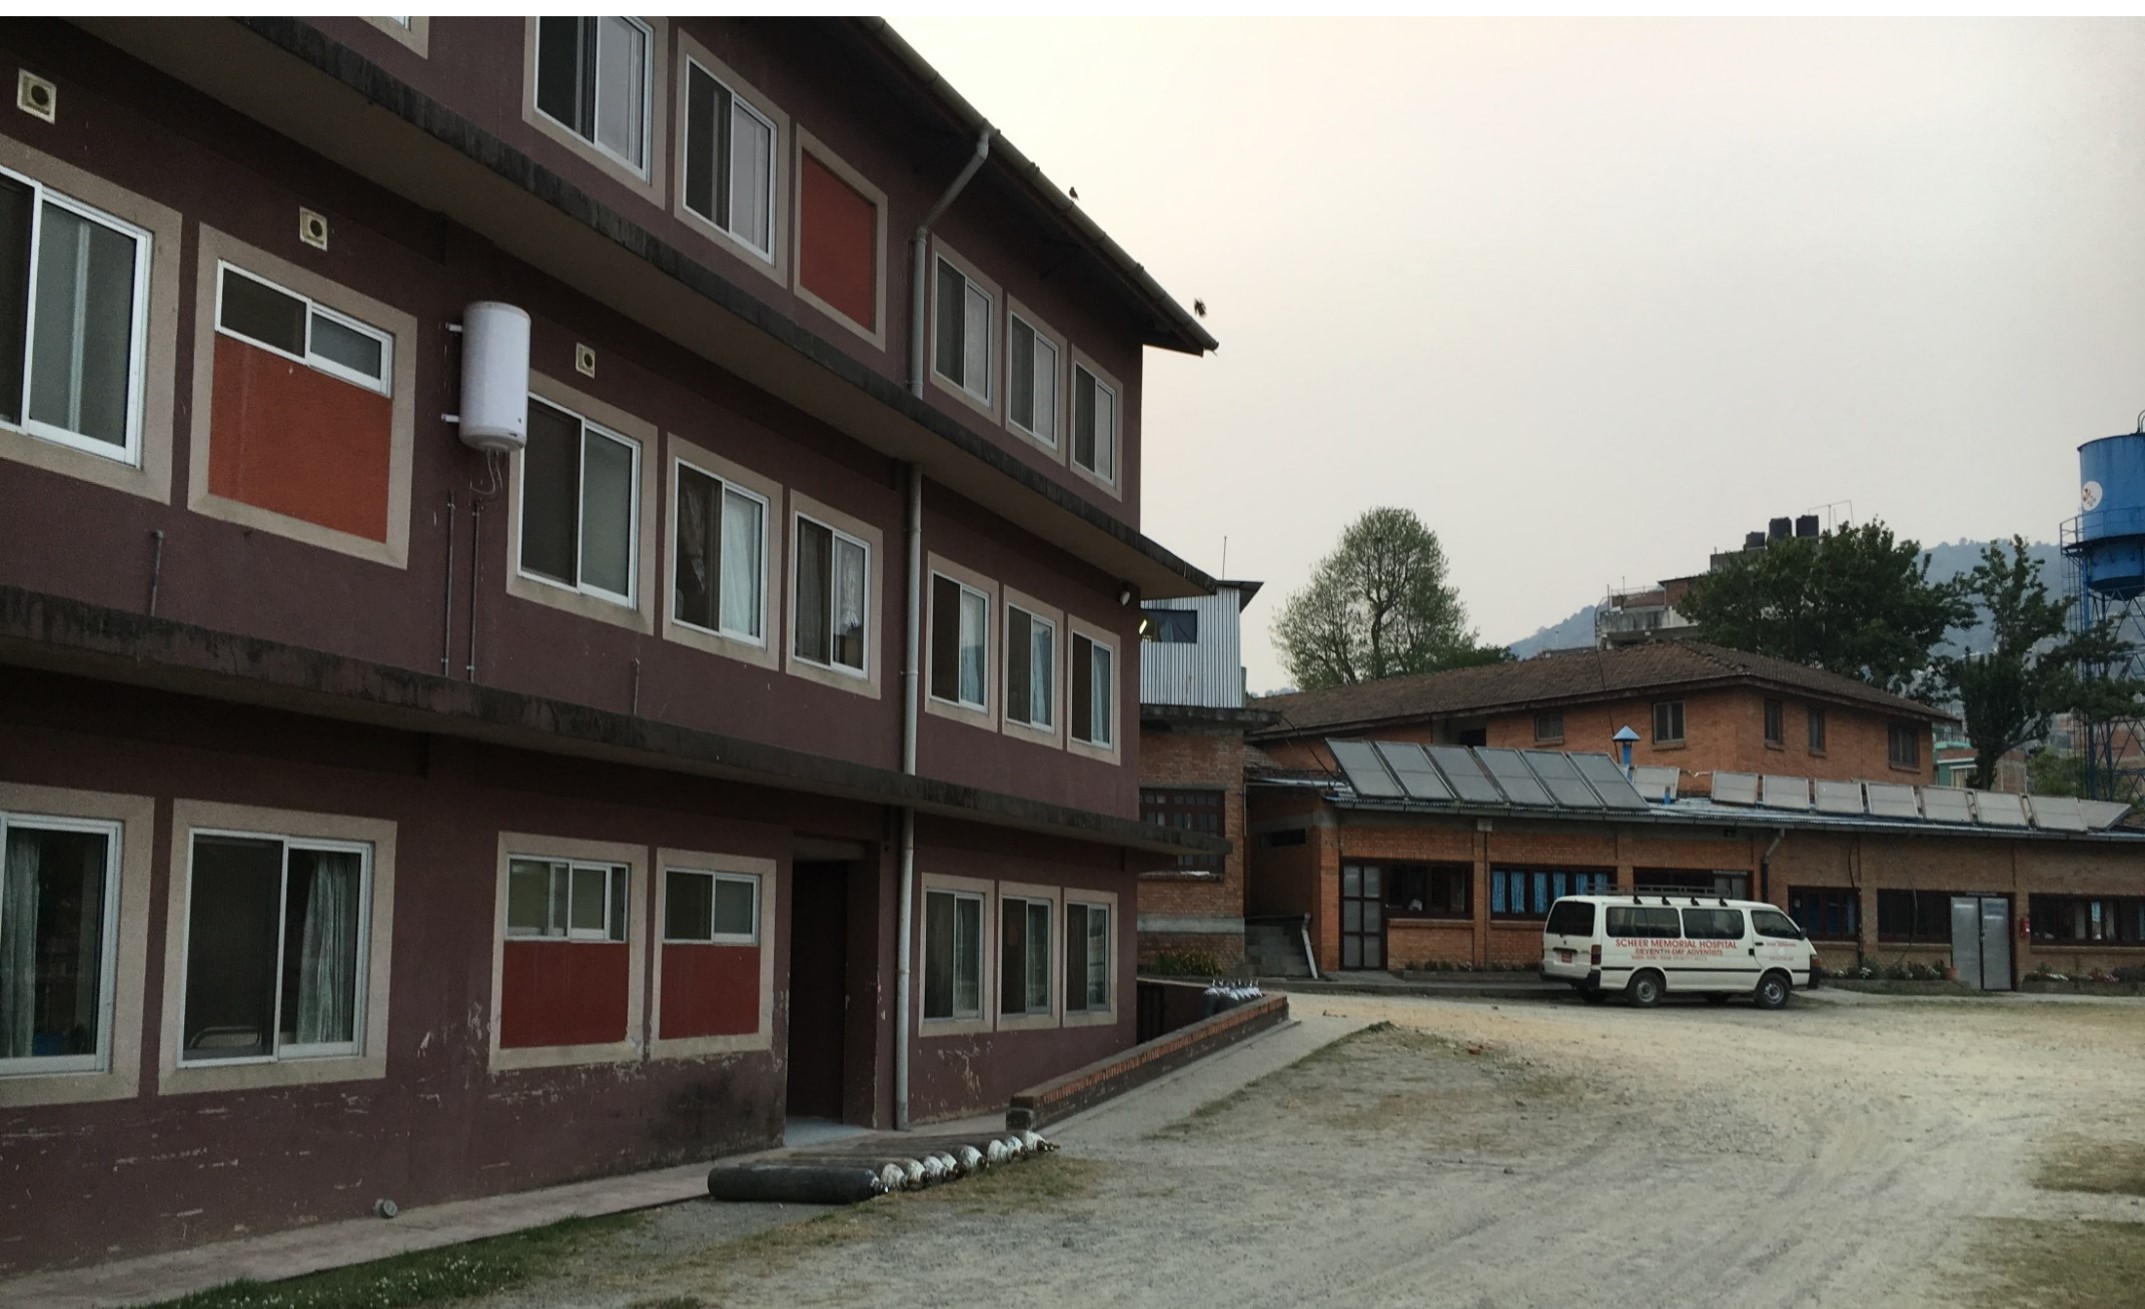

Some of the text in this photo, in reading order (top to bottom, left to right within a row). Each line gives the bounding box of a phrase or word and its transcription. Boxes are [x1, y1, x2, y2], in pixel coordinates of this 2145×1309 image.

[1615, 938, 1738, 950] SCHEER MEMORIAL HOSPITAL
